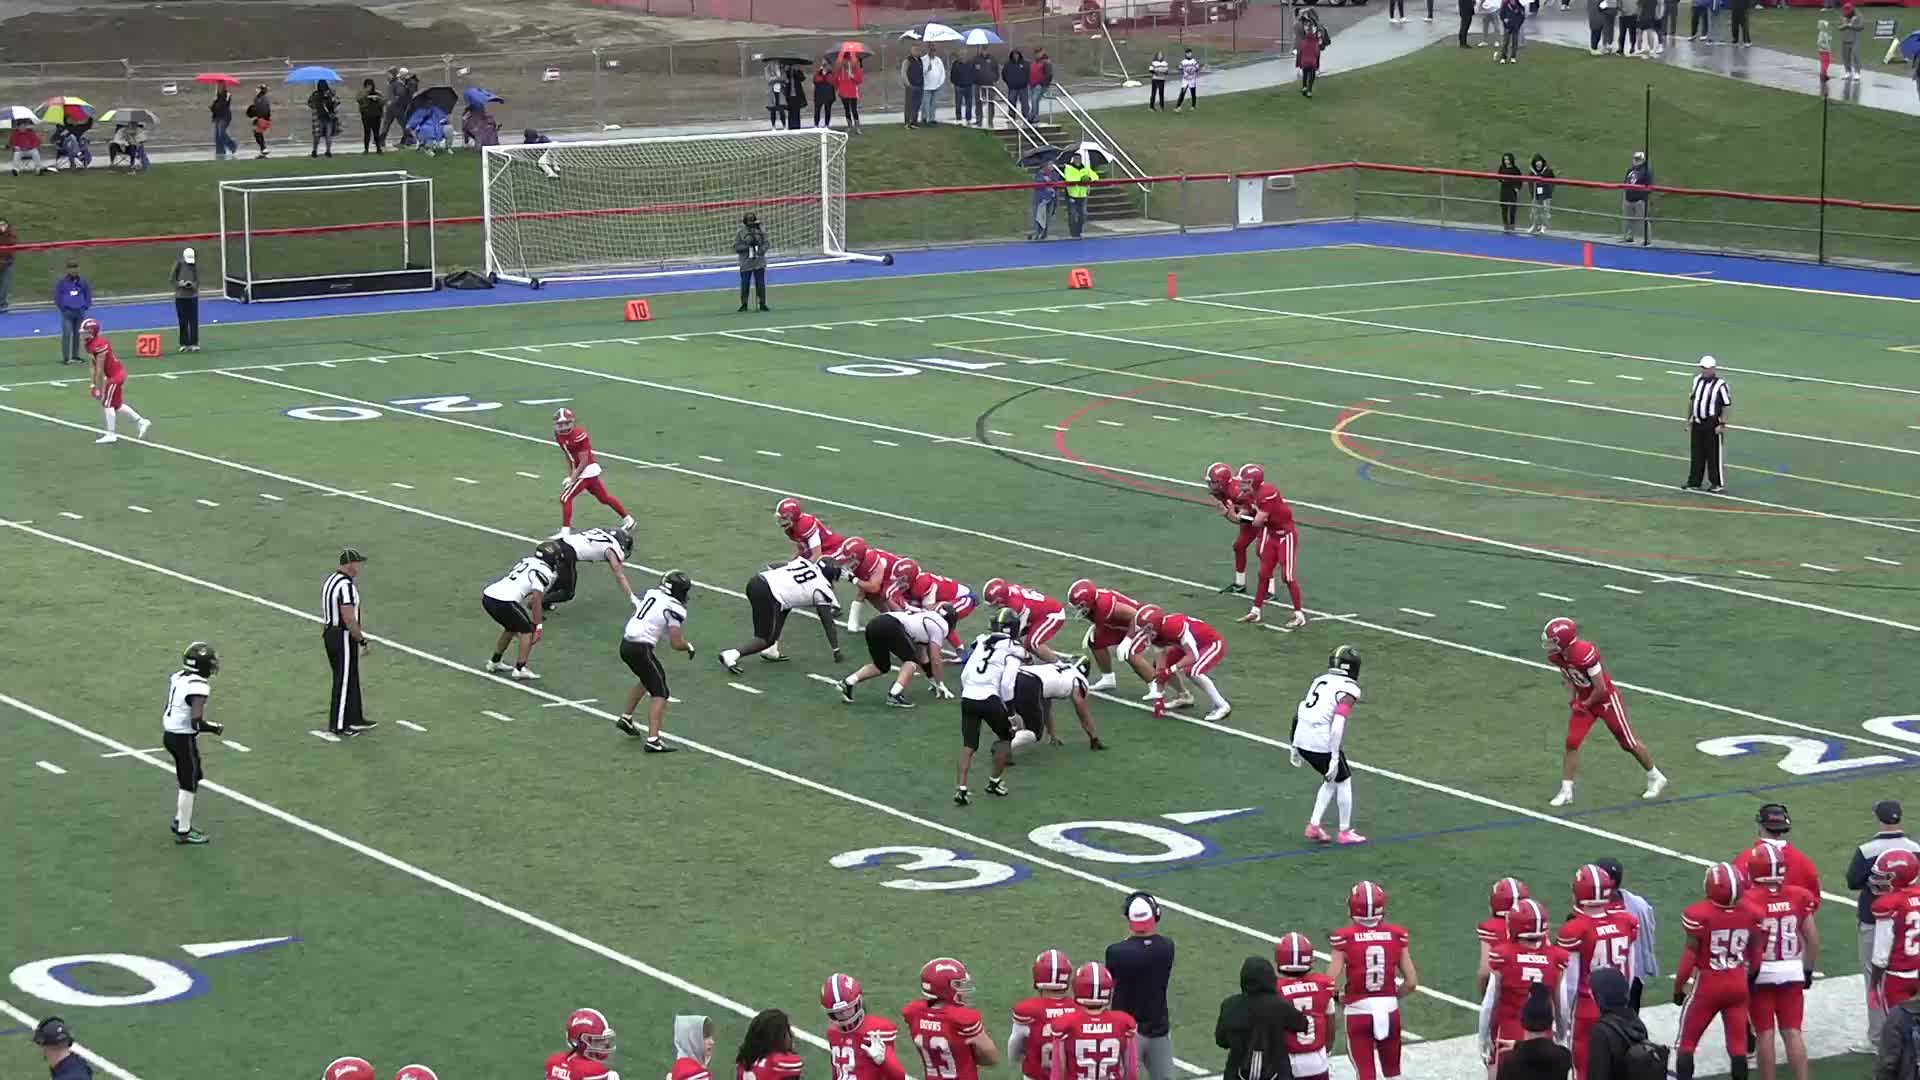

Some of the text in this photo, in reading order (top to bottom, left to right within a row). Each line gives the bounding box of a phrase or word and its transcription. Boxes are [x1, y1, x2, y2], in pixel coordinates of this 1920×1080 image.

[631, 302, 648, 320] 10
[138, 337, 158, 355] 20
[786, 560, 817, 585] 78
[636, 597, 656, 620] 0
[975, 642, 997, 674] 3
[1305, 680, 1329, 709] 5
[1761, 914, 1798, 961] 78
[1365, 945, 1385, 992] 8
[1592, 935, 1629, 974] 45
[914, 1033, 958, 1079] 13
[1075, 1038, 1120, 1080] 52
